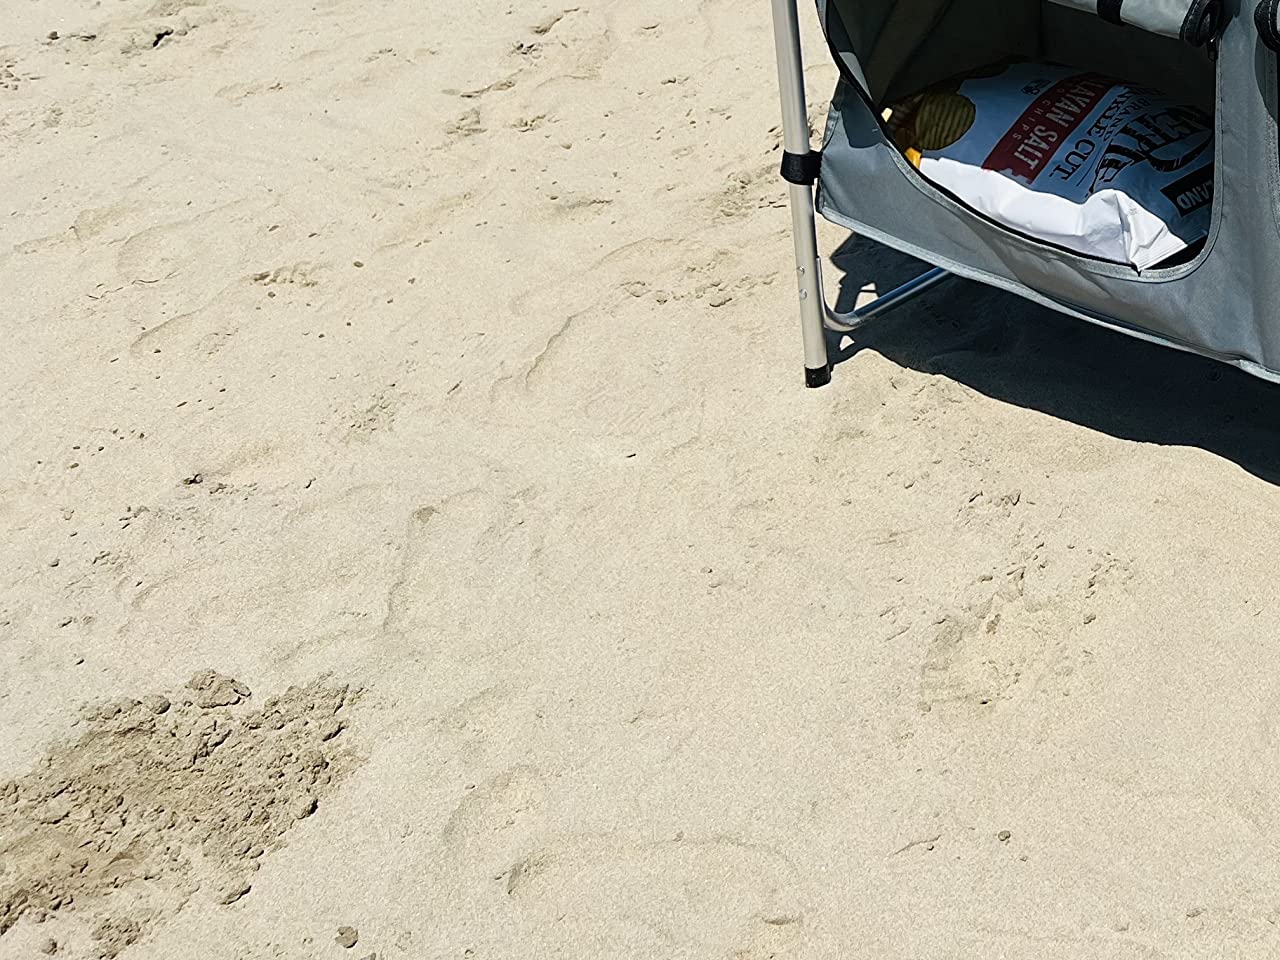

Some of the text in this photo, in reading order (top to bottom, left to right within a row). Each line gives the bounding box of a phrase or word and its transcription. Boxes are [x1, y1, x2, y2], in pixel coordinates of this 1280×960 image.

[1012, 100, 1052, 140] CHIPS
[1046, 80, 1104, 128] LAYAN
[1013, 124, 1058, 170] SALT
[1053, 139, 1096, 181] CUT
